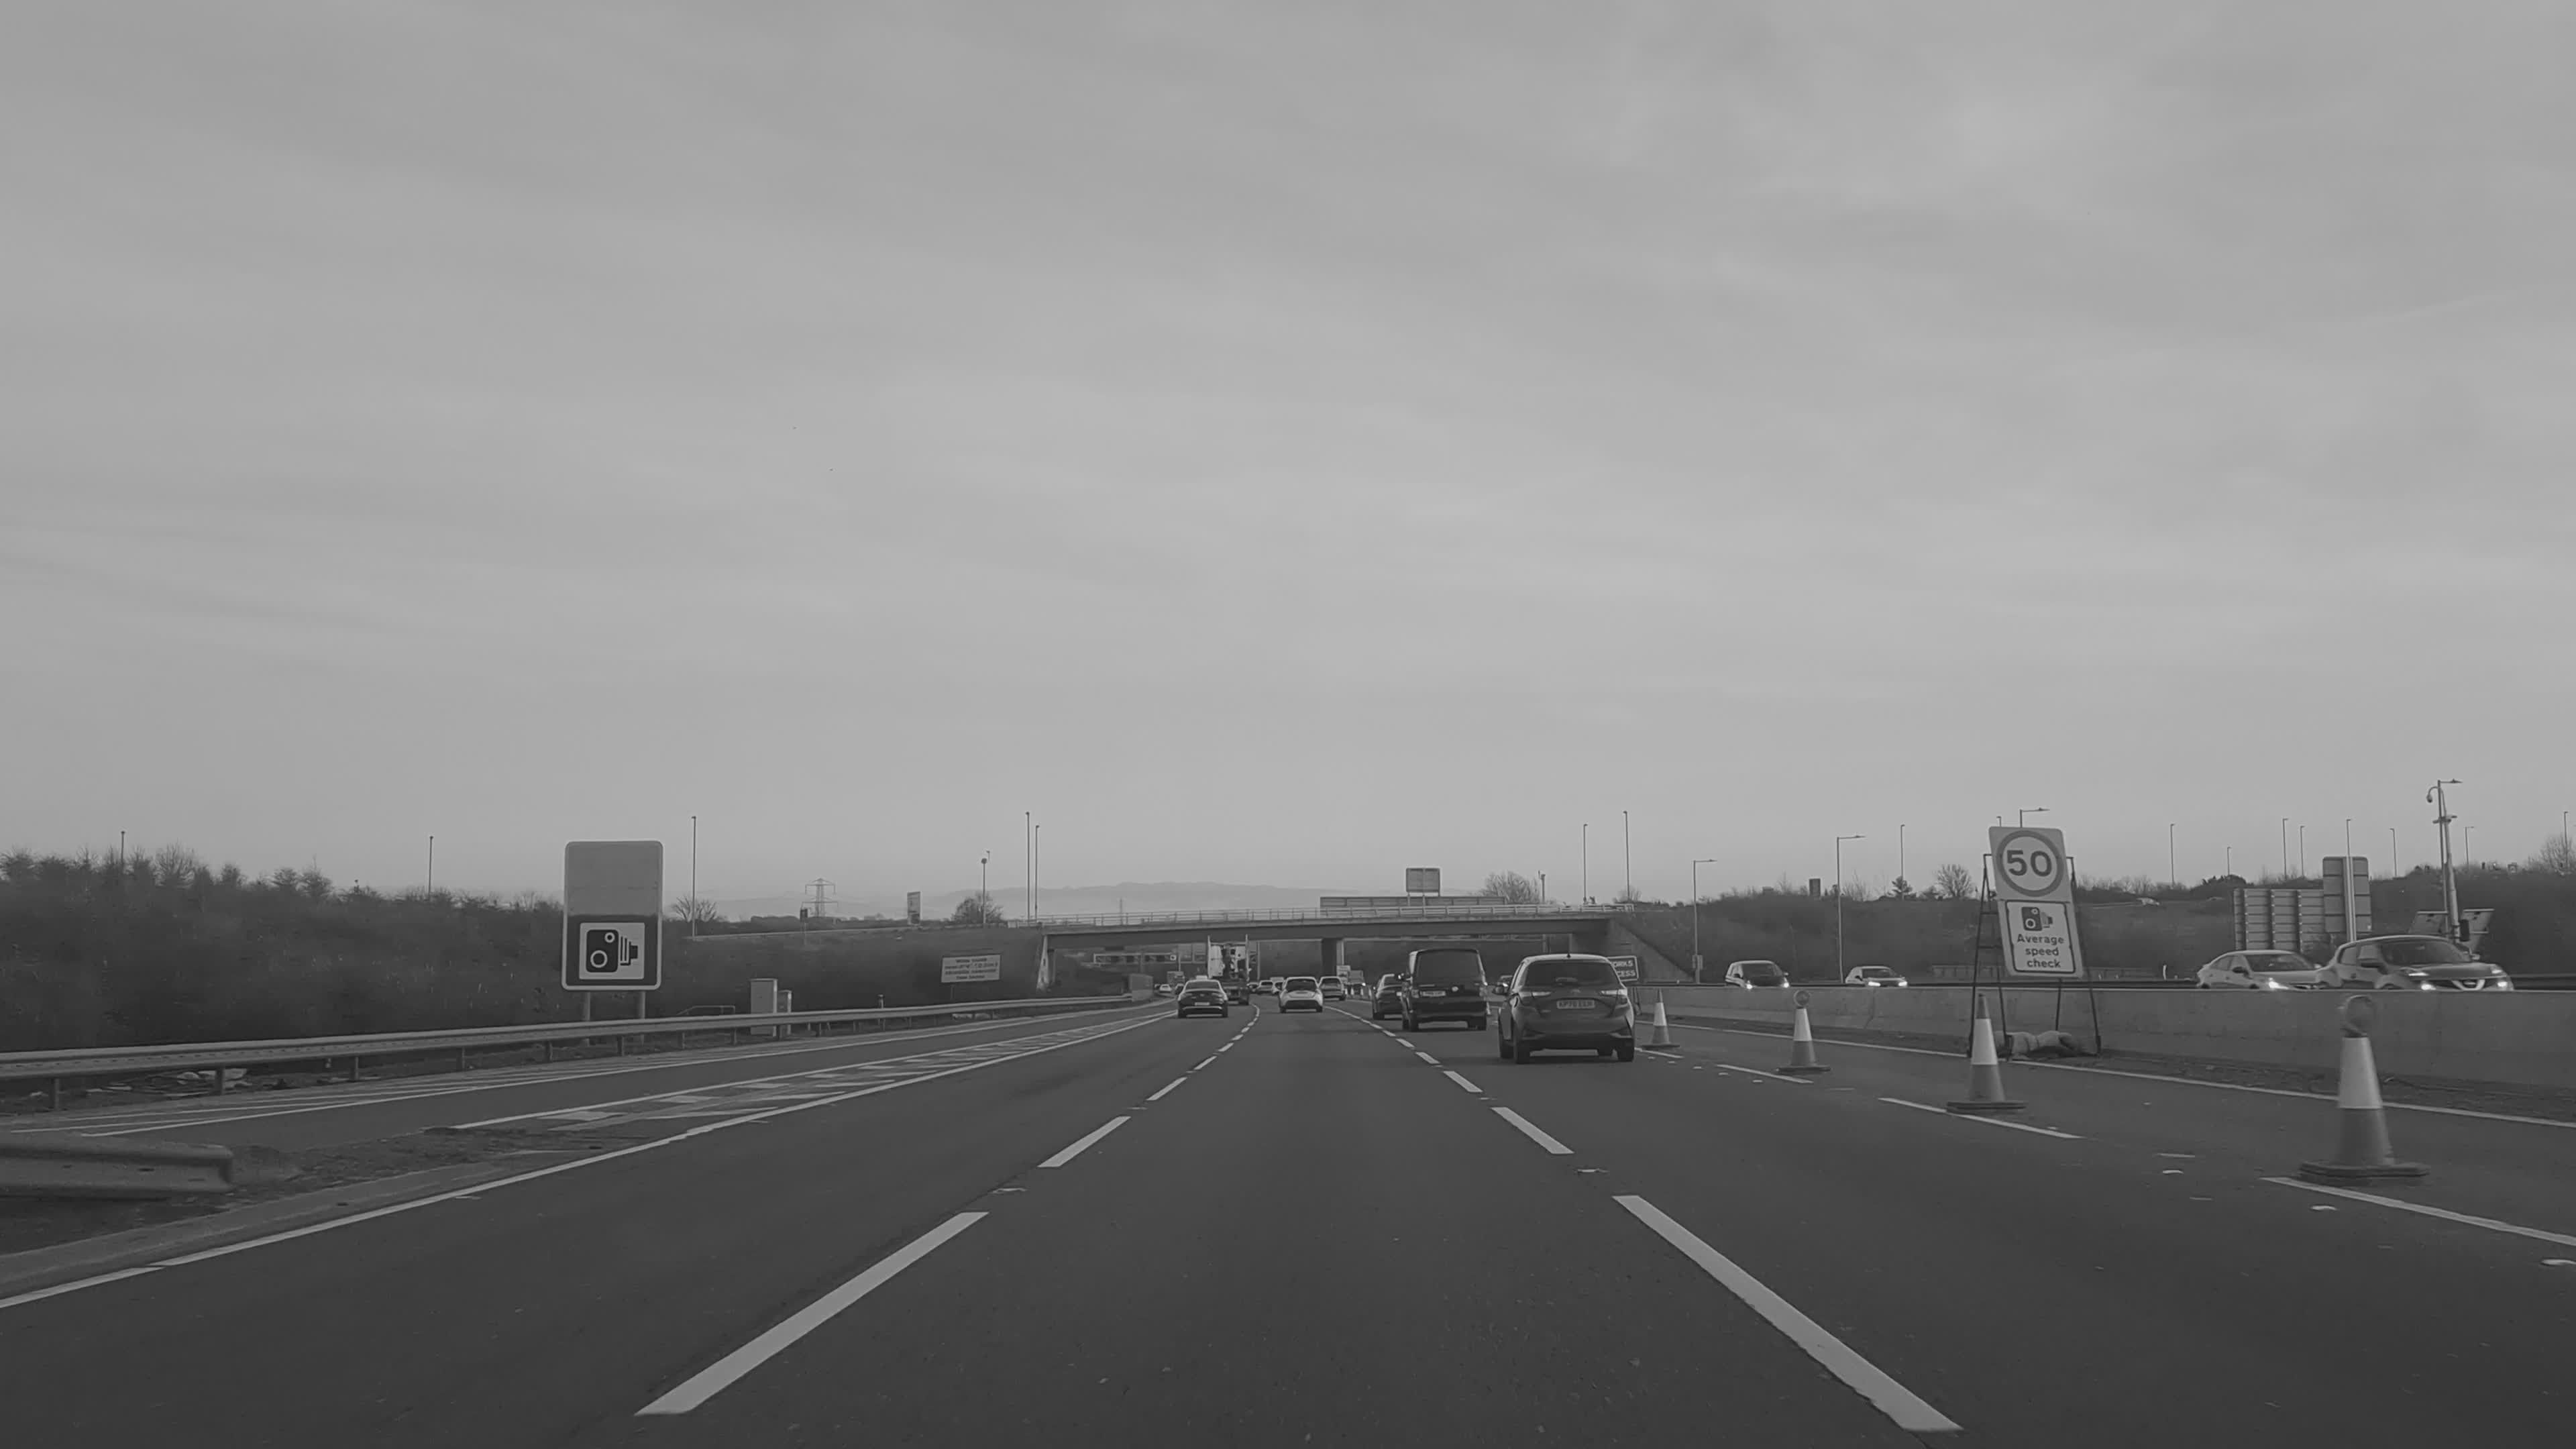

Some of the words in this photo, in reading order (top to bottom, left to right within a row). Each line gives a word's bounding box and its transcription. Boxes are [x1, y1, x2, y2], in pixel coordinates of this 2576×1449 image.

[2007, 850, 2052, 877] 50
[2017, 933, 2064, 945] Average
[2025, 947, 2059, 957] speed
[2027, 958, 2061, 968] check
